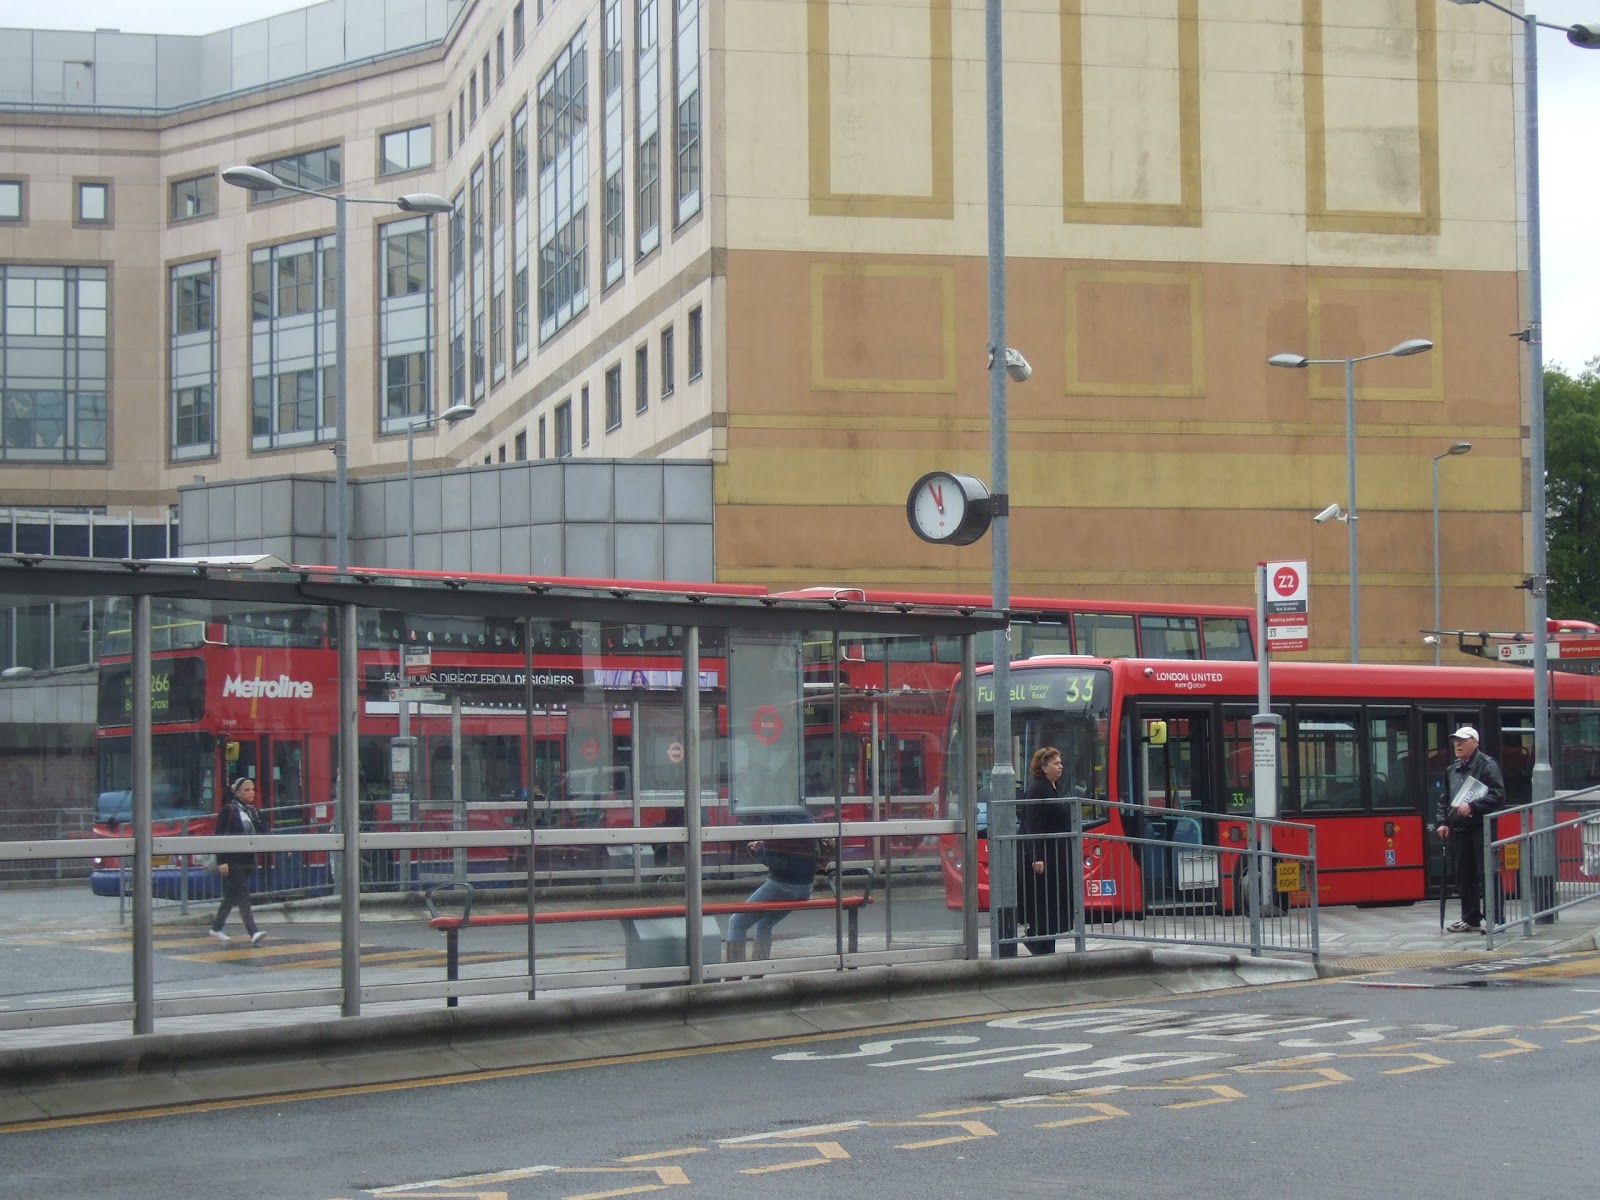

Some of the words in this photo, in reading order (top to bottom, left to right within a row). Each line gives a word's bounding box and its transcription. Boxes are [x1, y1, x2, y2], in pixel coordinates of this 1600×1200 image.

[1278, 575, 1294, 589] Z2
[1269, 630, 1277, 638] 33
[384, 672, 438, 684] FASIONS
[440, 673, 479, 684] DIRECT
[480, 674, 511, 684] FROM
[1156, 672, 1189, 681] LONDON
[1191, 673, 1223, 682] UNITED
[222, 673, 314, 699] Metroline
[1028, 683, 1050, 692] Stanley
[1065, 675, 1095, 703] 33
[977, 684, 1026, 702] Fuell
[1031, 692, 1046, 700] Road
[1232, 792, 1244, 807] 33
[1279, 866, 1297, 876] LOOK
[1279, 878, 1297, 888] RIGHT
